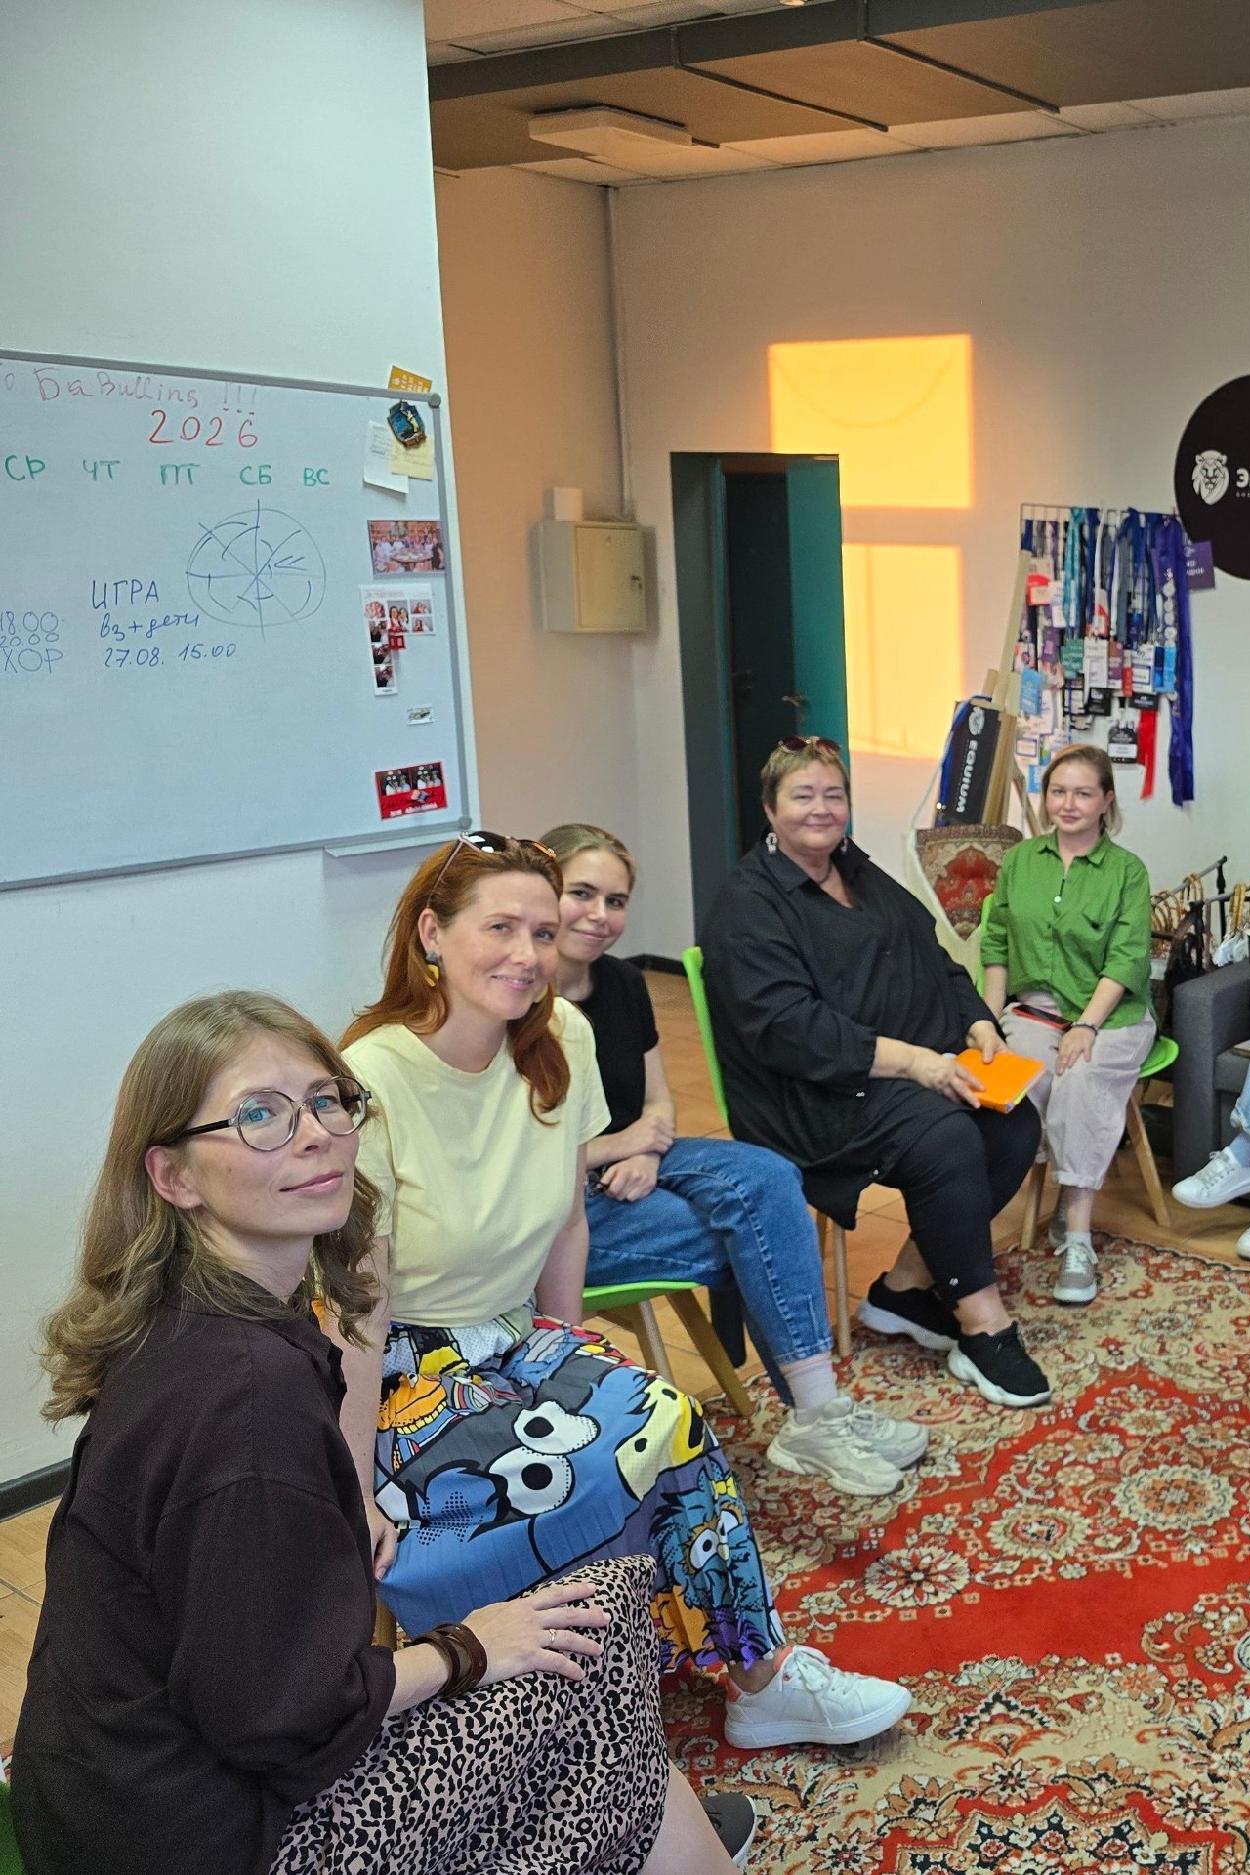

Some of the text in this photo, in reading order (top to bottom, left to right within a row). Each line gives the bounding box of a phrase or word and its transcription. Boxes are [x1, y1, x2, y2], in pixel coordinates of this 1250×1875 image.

[149, 410, 258, 448] 2026
[4, 454, 330, 487] СР ЧТ ПТ СБ ВС
[92, 579, 160, 609] ИГРА
[4, 648, 64, 673] ХОР
[955, 739, 979, 814] EQUIUM
